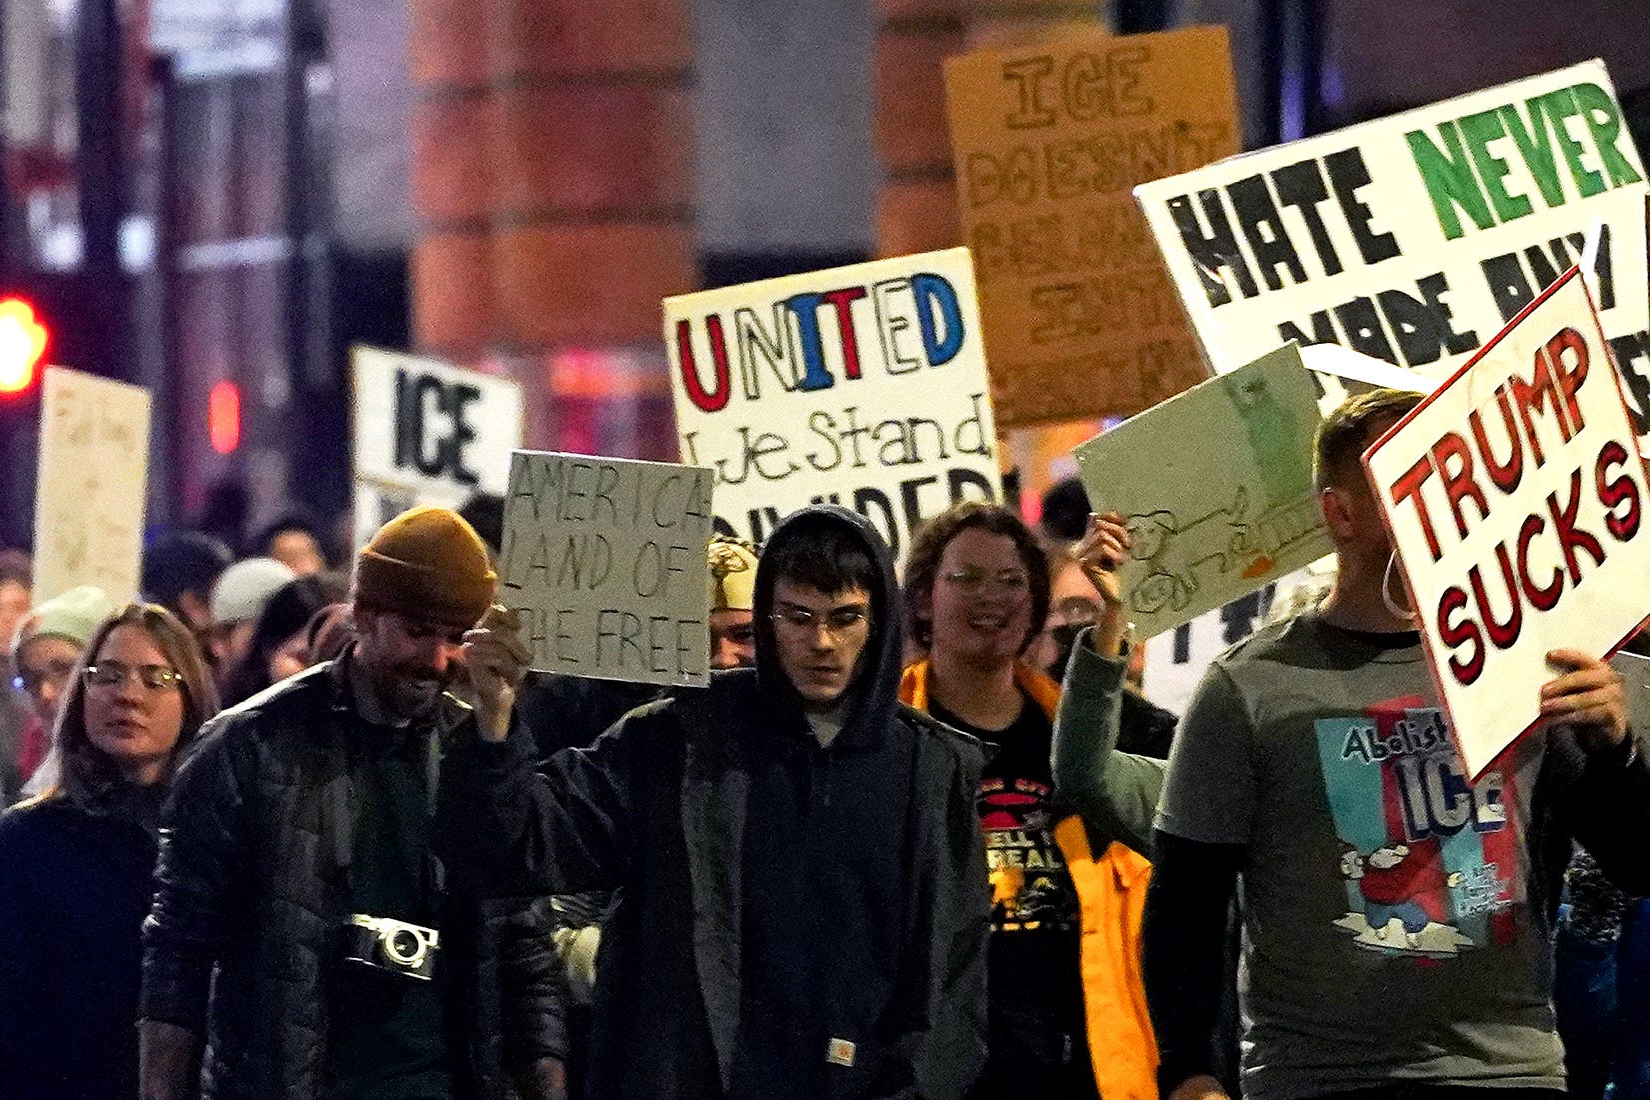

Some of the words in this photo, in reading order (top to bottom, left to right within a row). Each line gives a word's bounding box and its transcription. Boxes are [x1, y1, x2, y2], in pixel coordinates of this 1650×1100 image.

[1002, 45, 1158, 130] ICE
[1166, 146, 1402, 308] HATE
[1405, 82, 1644, 241] NEVER
[674, 272, 967, 412] UNITED
[394, 367, 481, 488] ICE
[805, 392, 992, 472] Stand
[1390, 326, 1590, 564] TRUMP
[510, 456, 709, 531] AMERICA
[504, 529, 613, 590] LAND
[633, 540, 689, 598] OF
[1436, 439, 1642, 687] SUCKS
[596, 609, 703, 676] FREE
